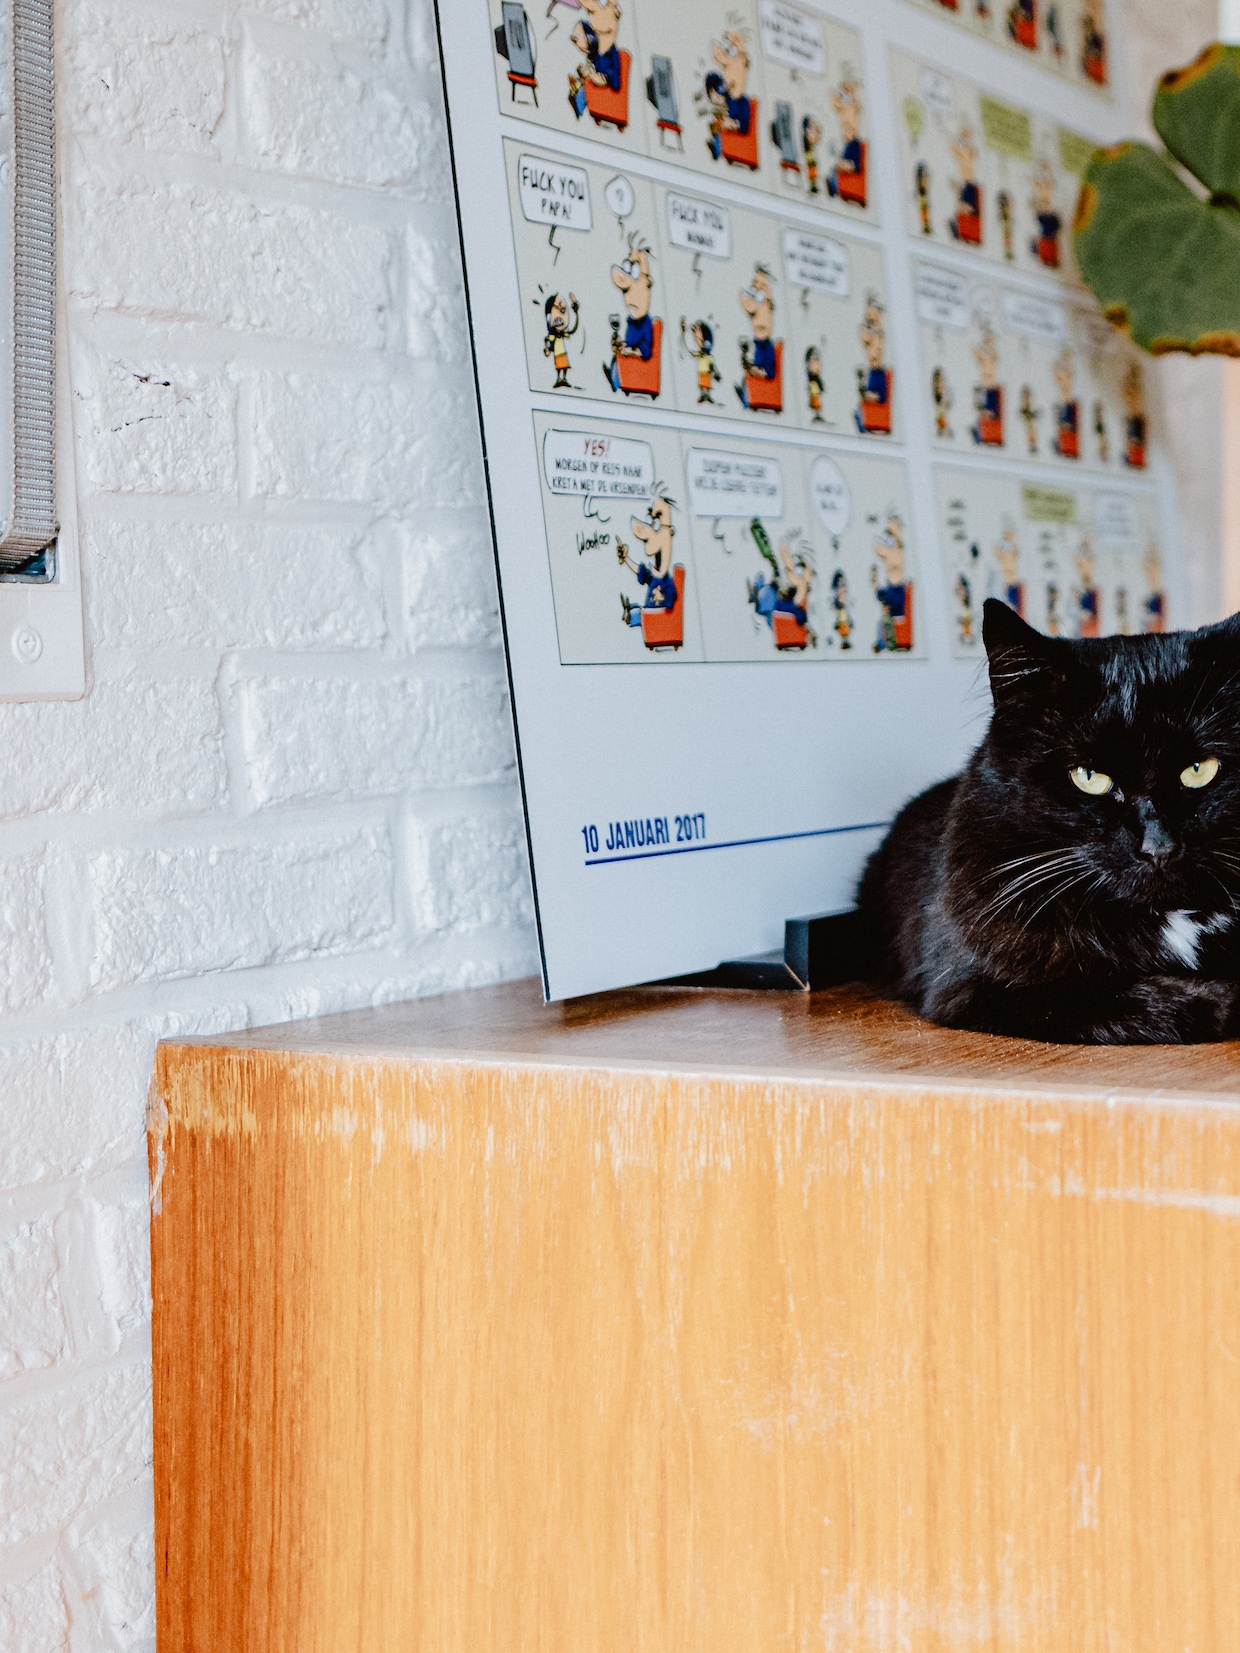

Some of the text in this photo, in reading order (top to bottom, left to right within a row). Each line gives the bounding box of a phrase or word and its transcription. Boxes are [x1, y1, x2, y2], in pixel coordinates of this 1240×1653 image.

[522, 166, 585, 201] FUCK YOU
[584, 438, 611, 457] YES!
[555, 457, 588, 472] MORGEN
[590, 460, 600, 473] OP
[552, 475, 578, 490] KRETA
[580, 478, 595, 491] MET
[598, 479, 608, 493] DE
[581, 812, 706, 854] 10 JANUARI 2017
